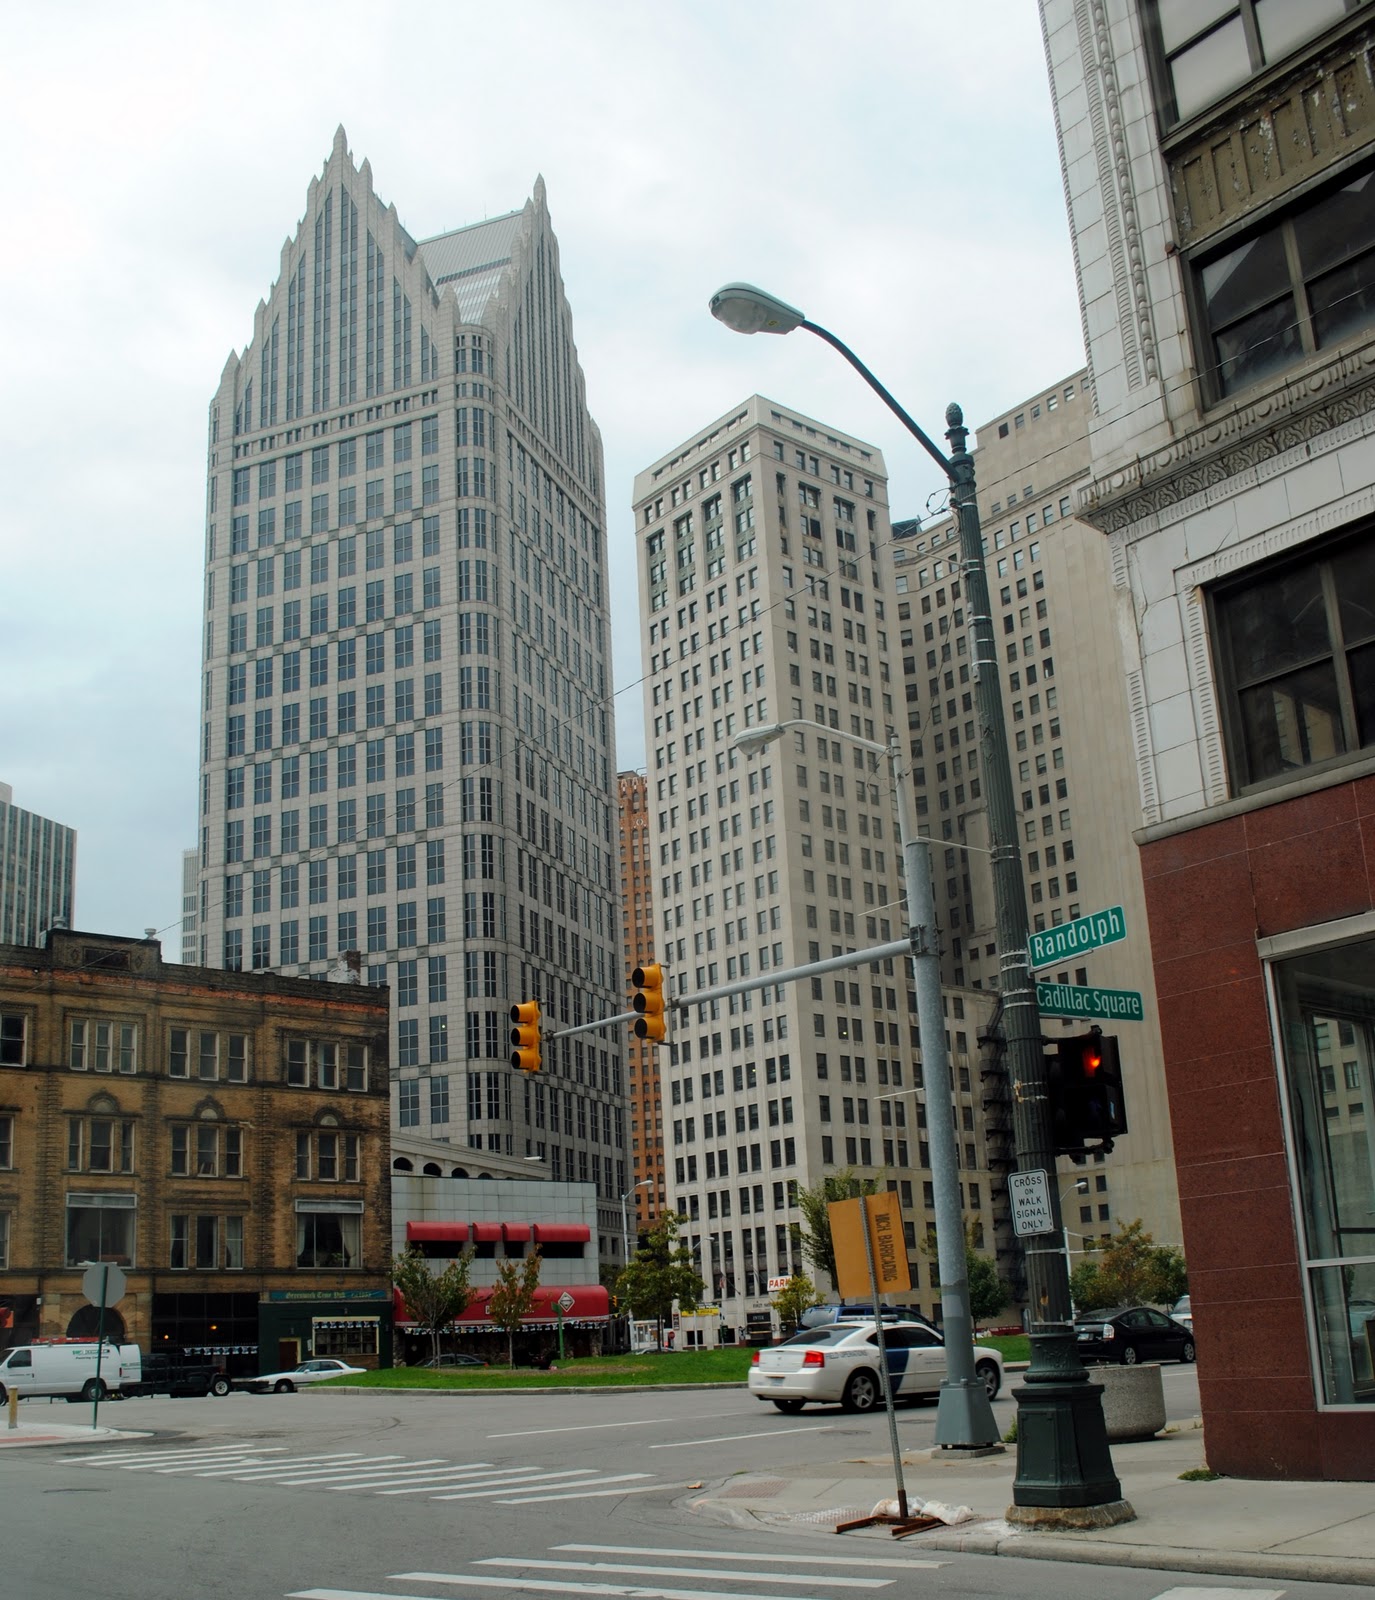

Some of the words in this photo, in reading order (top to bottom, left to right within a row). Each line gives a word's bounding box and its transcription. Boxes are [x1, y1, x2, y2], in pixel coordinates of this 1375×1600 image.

[1034, 911, 1120, 959] Randolph
[1036, 986, 1091, 1011] Cadillac
[1093, 991, 1140, 1018] Square
[1014, 1176, 1042, 1187] CROSS
[1019, 1196, 1042, 1206] WALK
[1016, 1207, 1047, 1219] SIGNAL
[1022, 1220, 1043, 1230] ONLY
[878, 1234, 898, 1282] BARRICADING
